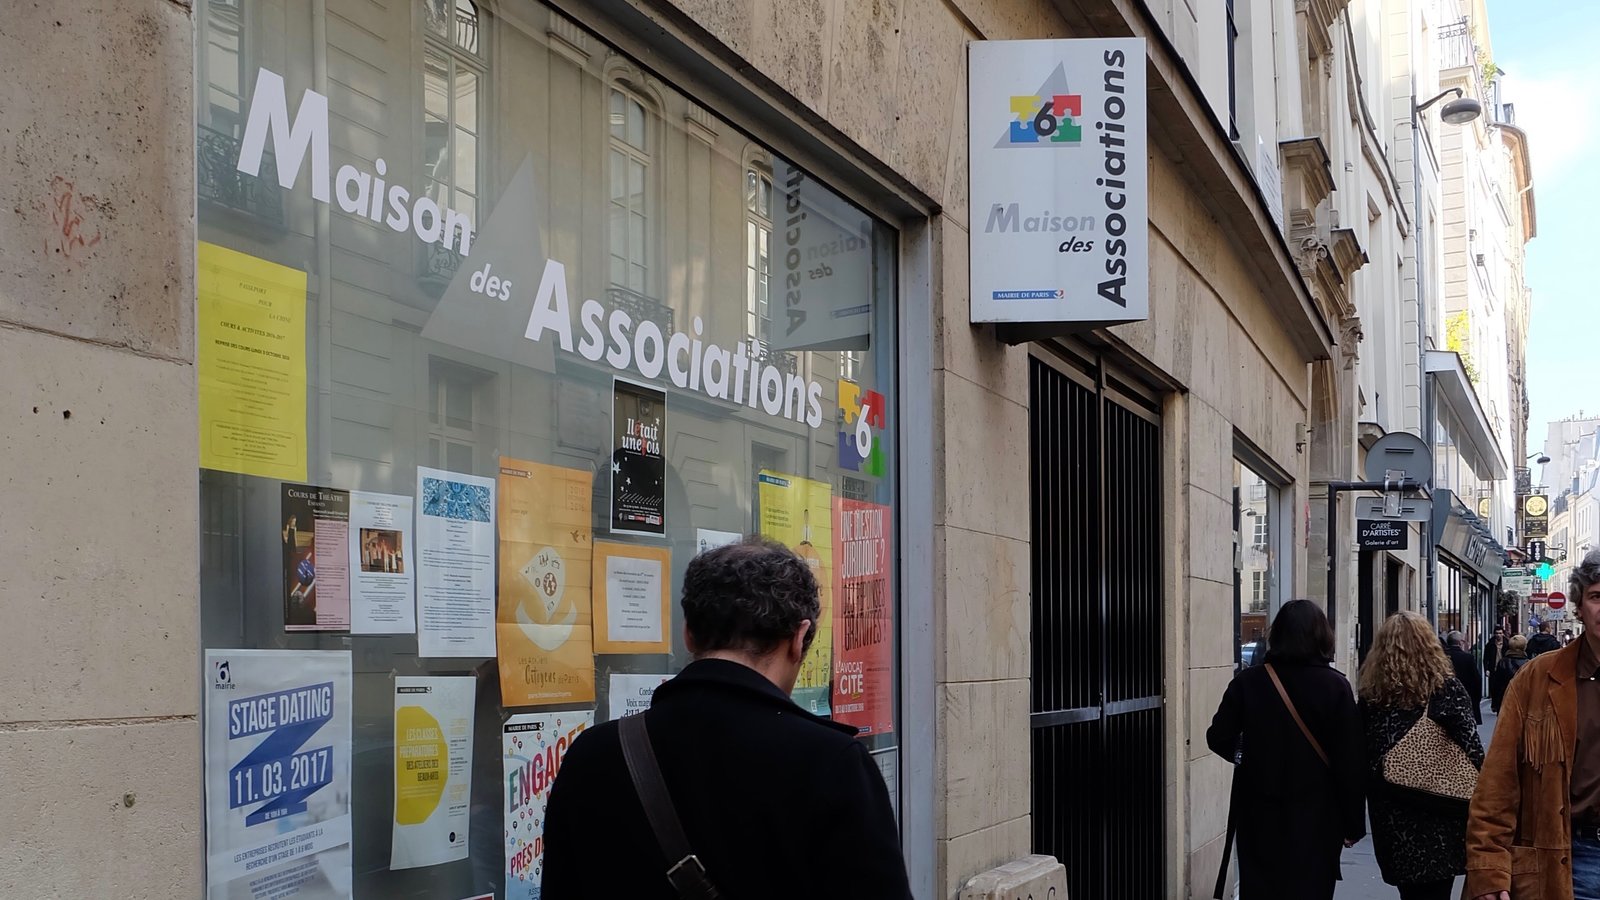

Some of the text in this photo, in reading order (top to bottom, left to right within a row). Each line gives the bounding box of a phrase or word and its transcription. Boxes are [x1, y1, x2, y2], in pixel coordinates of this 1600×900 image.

[1033, 101, 1057, 137] 6
[236, 67, 476, 257] Maison
[1095, 49, 1127, 308] Associations
[984, 203, 1096, 233] Maison
[1058, 236, 1094, 253] des
[470, 263, 513, 302] des
[524, 258, 823, 428] Associations
[621, 435, 642, 451] une
[627, 417, 635, 436] Il
[855, 404, 872, 458] 6
[840, 508, 882, 542] UNE QUESTION
[1370, 522, 1391, 530] CARRÉ
[841, 538, 879, 579] JURIDIQUE
[835, 660, 864, 674] L'AVOCAT
[215, 682, 236, 690] mairie
[231, 687, 331, 736] STAGE DATING
[235, 750, 328, 804] 11. 03. 2017
[511, 841, 533, 879] PRÈS
